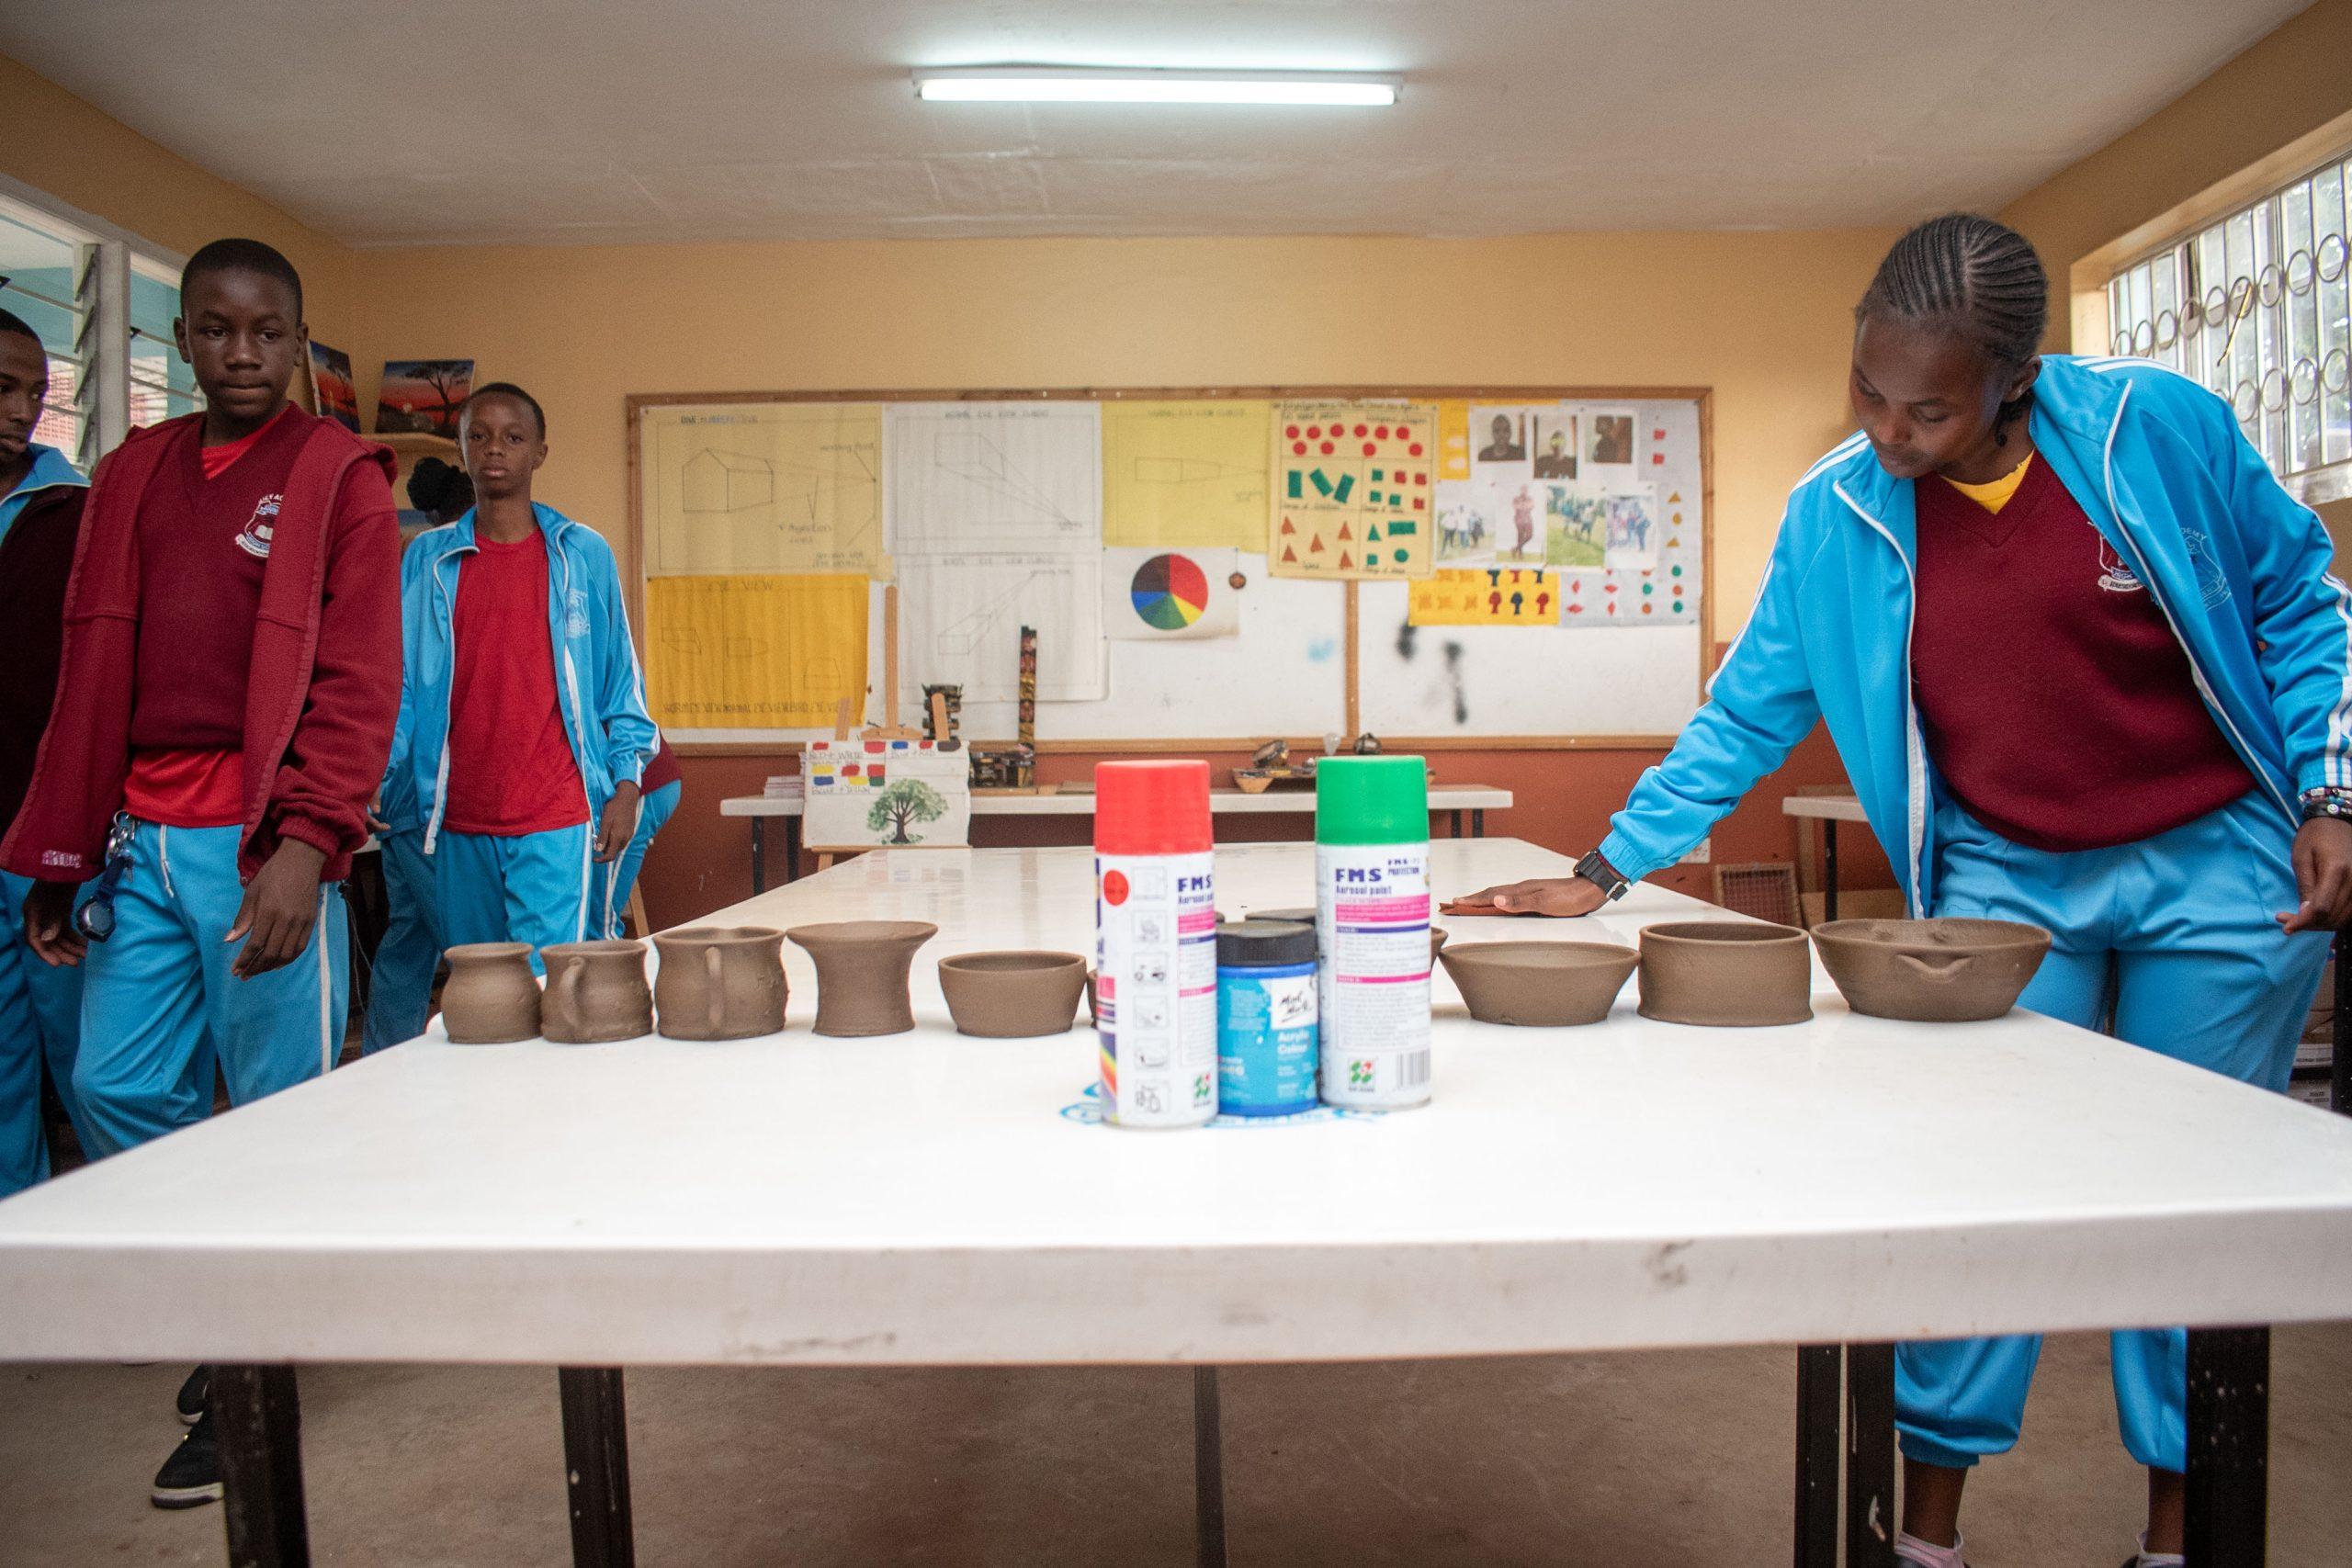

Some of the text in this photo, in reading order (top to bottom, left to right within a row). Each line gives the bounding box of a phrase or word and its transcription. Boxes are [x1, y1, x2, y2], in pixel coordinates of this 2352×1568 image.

[2180, 526, 2208, 540] DEMY
[1177, 874, 1212, 892] FMS
[1336, 868, 1382, 883] FMS
